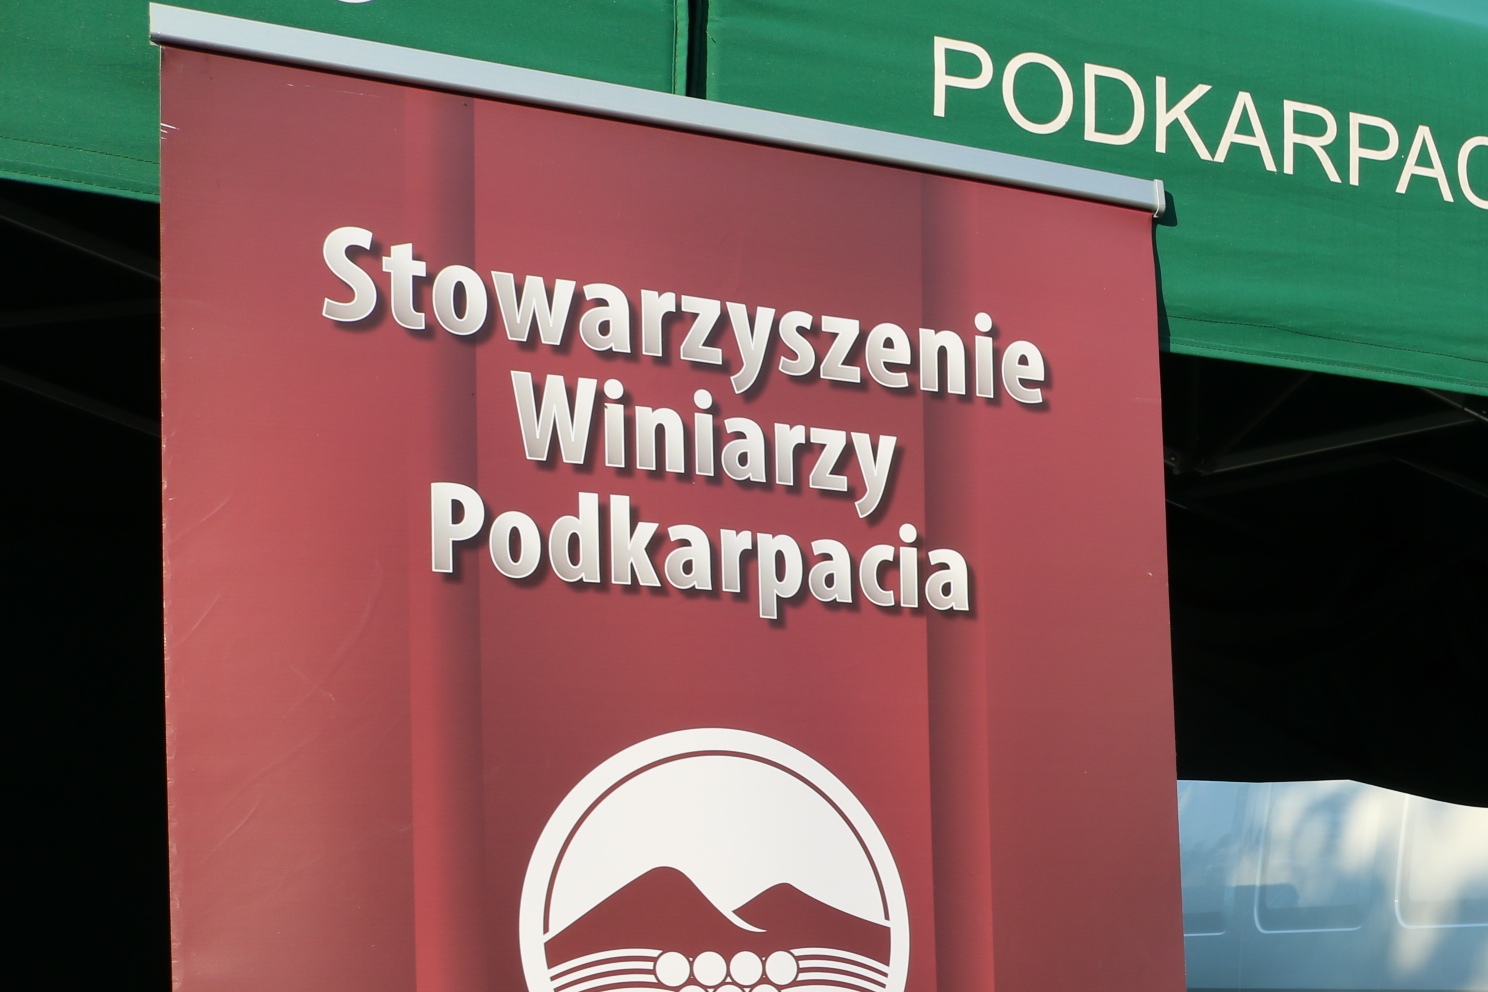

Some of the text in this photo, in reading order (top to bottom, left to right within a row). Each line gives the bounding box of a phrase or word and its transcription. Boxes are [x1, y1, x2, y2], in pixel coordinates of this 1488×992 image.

[321, 226, 1046, 405] Stowarzyszenie
[511, 370, 896, 519] Winiarzy
[430, 482, 969, 621] Podkarpacia
